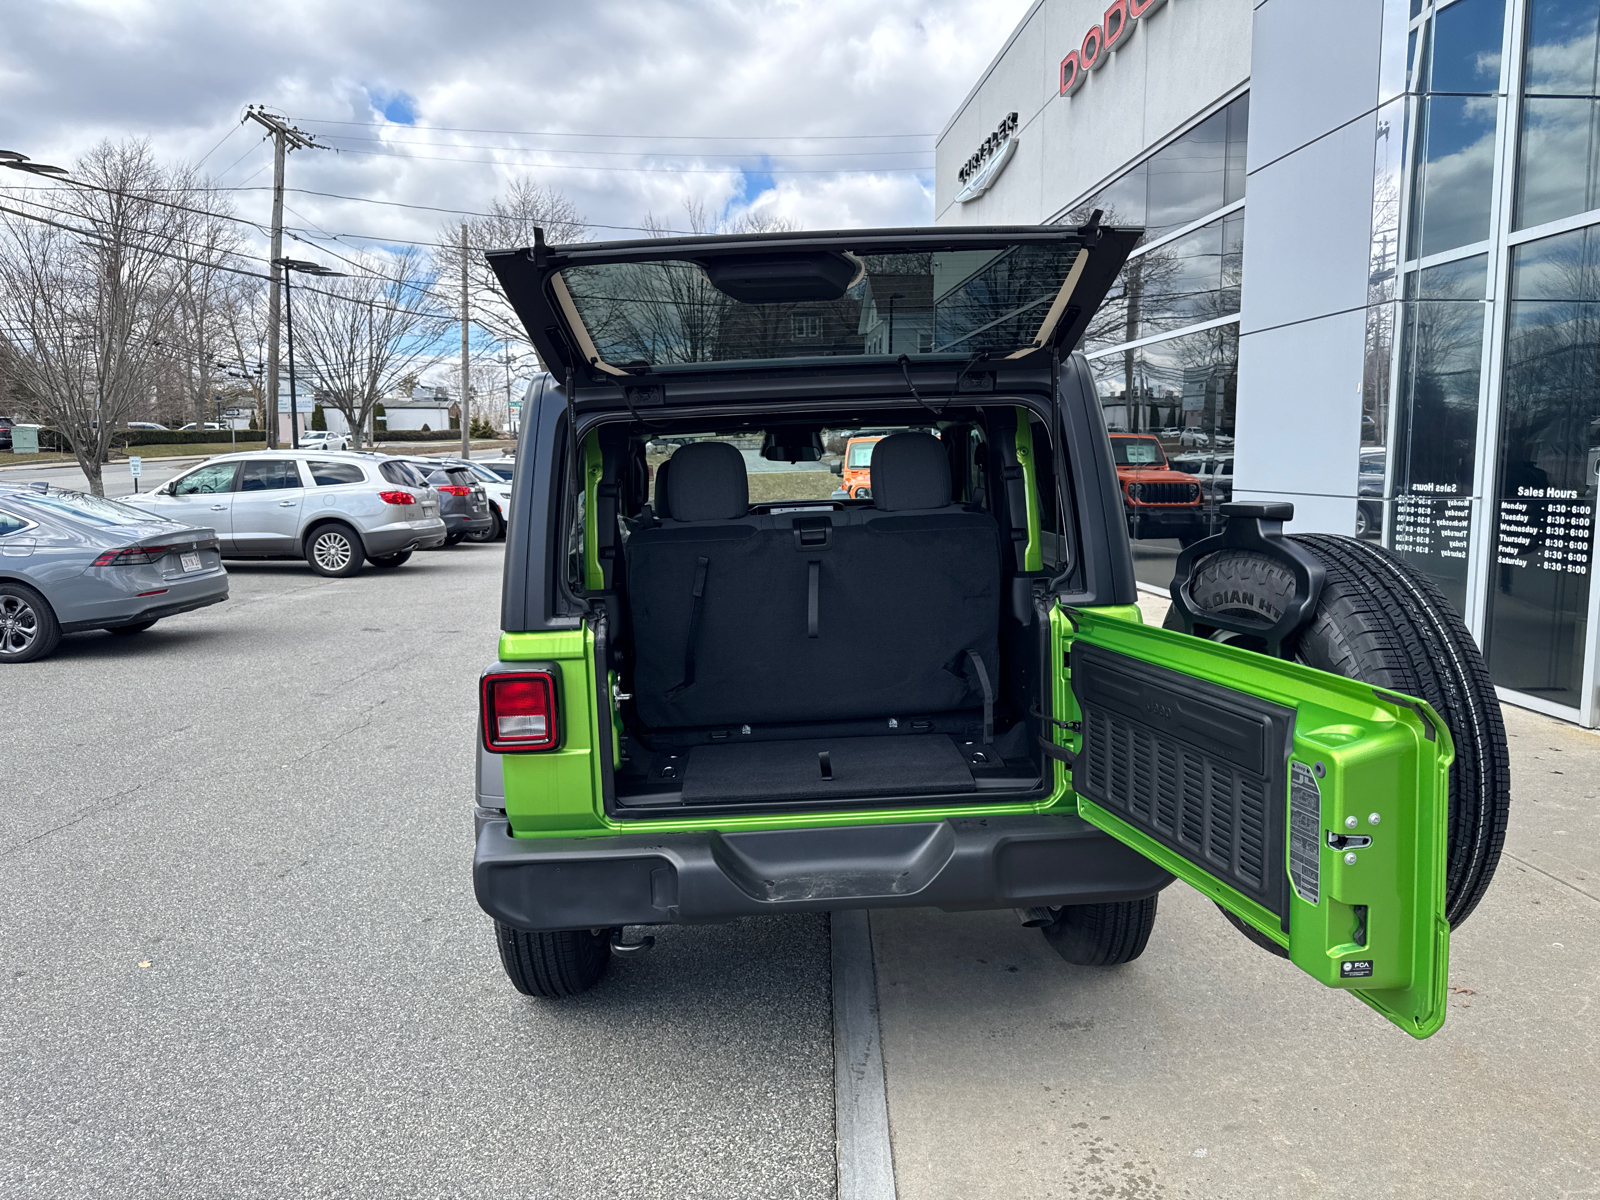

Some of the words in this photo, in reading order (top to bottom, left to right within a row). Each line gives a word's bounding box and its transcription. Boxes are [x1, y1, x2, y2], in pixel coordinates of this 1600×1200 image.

[958, 112, 1018, 182] CHRYSLER
[1517, 486, 1544, 497] Sales
[1546, 487, 1578, 499] Hours
[1501, 501, 1527, 512] Monday
[1501, 512, 1529, 523] Tuesday
[1500, 523, 1538, 535] Wednesday
[1499, 534, 1530, 546] Thursday
[1498, 545, 1519, 555] Friday
[1497, 555, 1527, 568] Saturday
[1203, 590, 1254, 610] ADIAN
